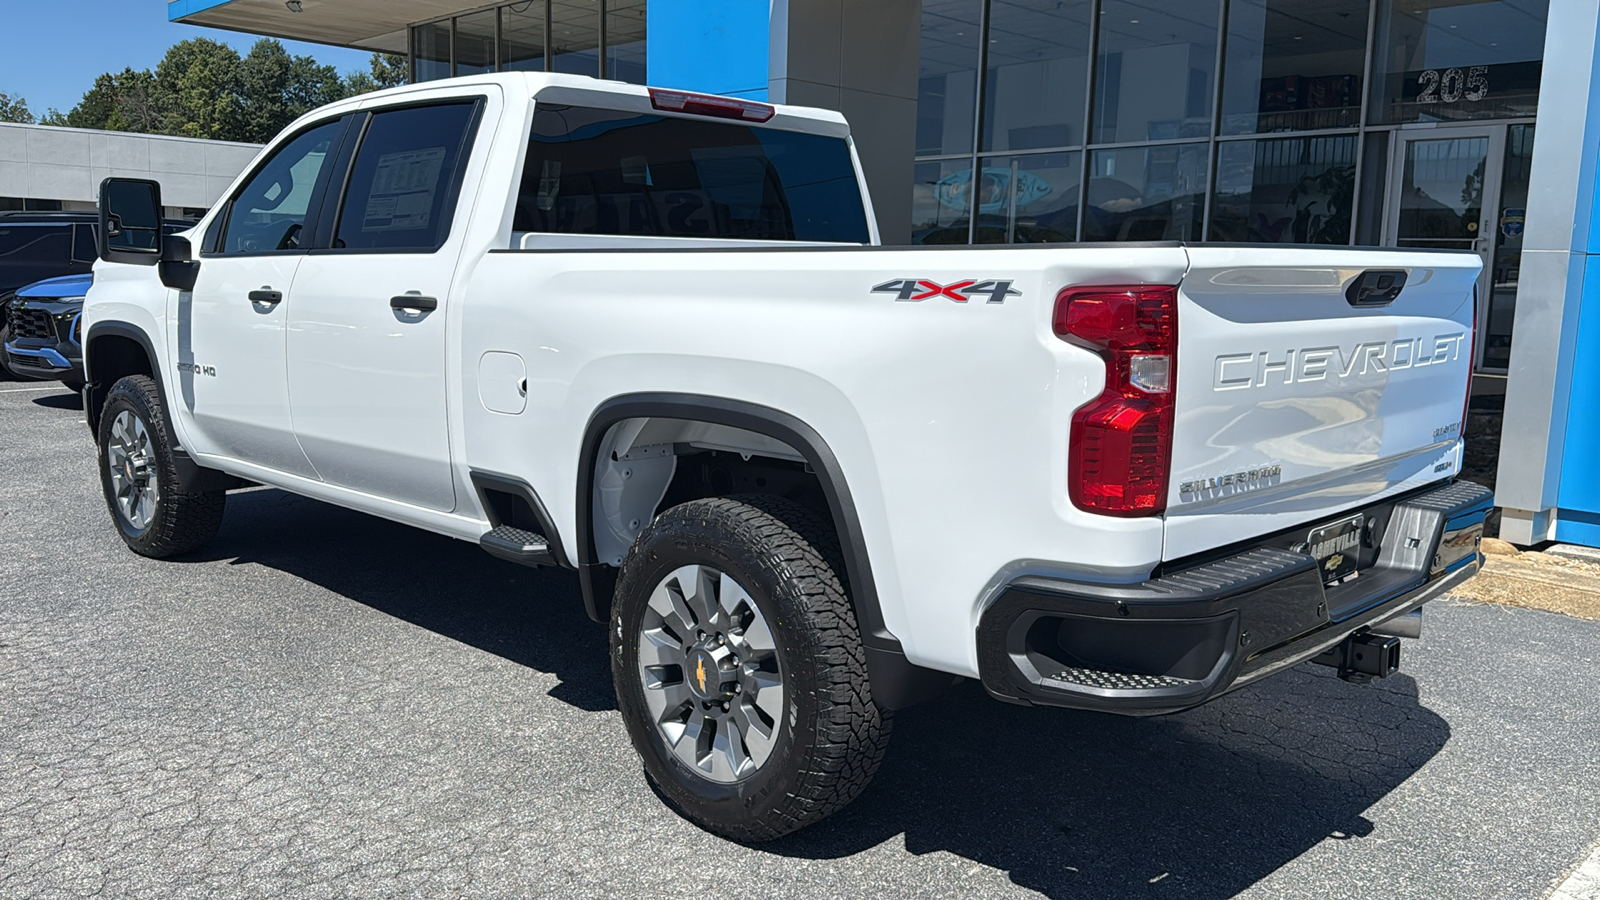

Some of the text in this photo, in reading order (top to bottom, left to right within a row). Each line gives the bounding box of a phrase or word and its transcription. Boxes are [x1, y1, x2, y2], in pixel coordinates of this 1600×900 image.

[1416, 66, 1489, 104] 205
[1213, 332, 1465, 391] CHEVROLET
[1179, 464, 1281, 493] SILVERADO
[1310, 529, 1361, 560] ASHEVILLE
